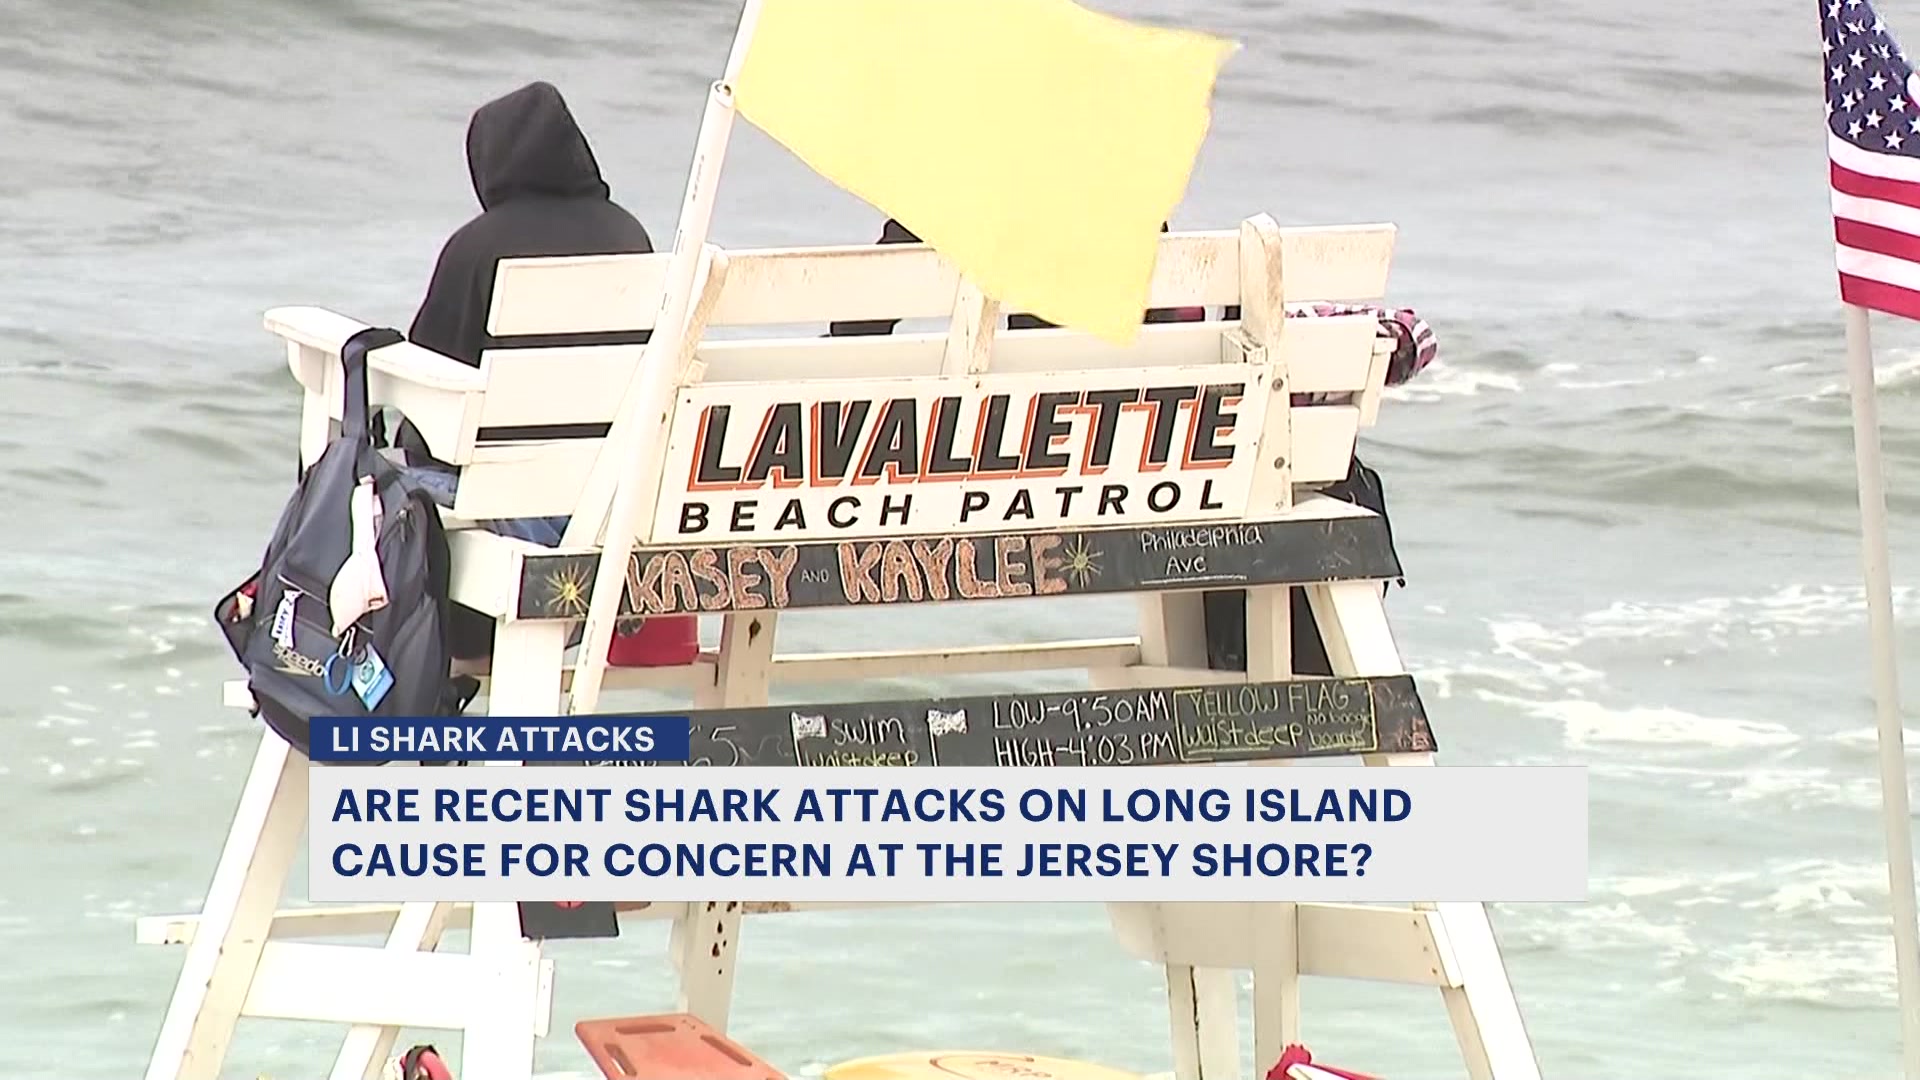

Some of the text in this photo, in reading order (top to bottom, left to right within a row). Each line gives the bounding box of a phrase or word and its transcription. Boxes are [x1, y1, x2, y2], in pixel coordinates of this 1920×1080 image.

[687, 383, 1245, 491] LAVALLETTE
[679, 480, 1224, 534] BEACH PATROL
[626, 535, 1068, 613] KASEY AND KAYLEE
[1190, 686, 1279, 717] YELLOW
[1287, 682, 1349, 713] FLAG
[1140, 731, 1177, 759] PM
